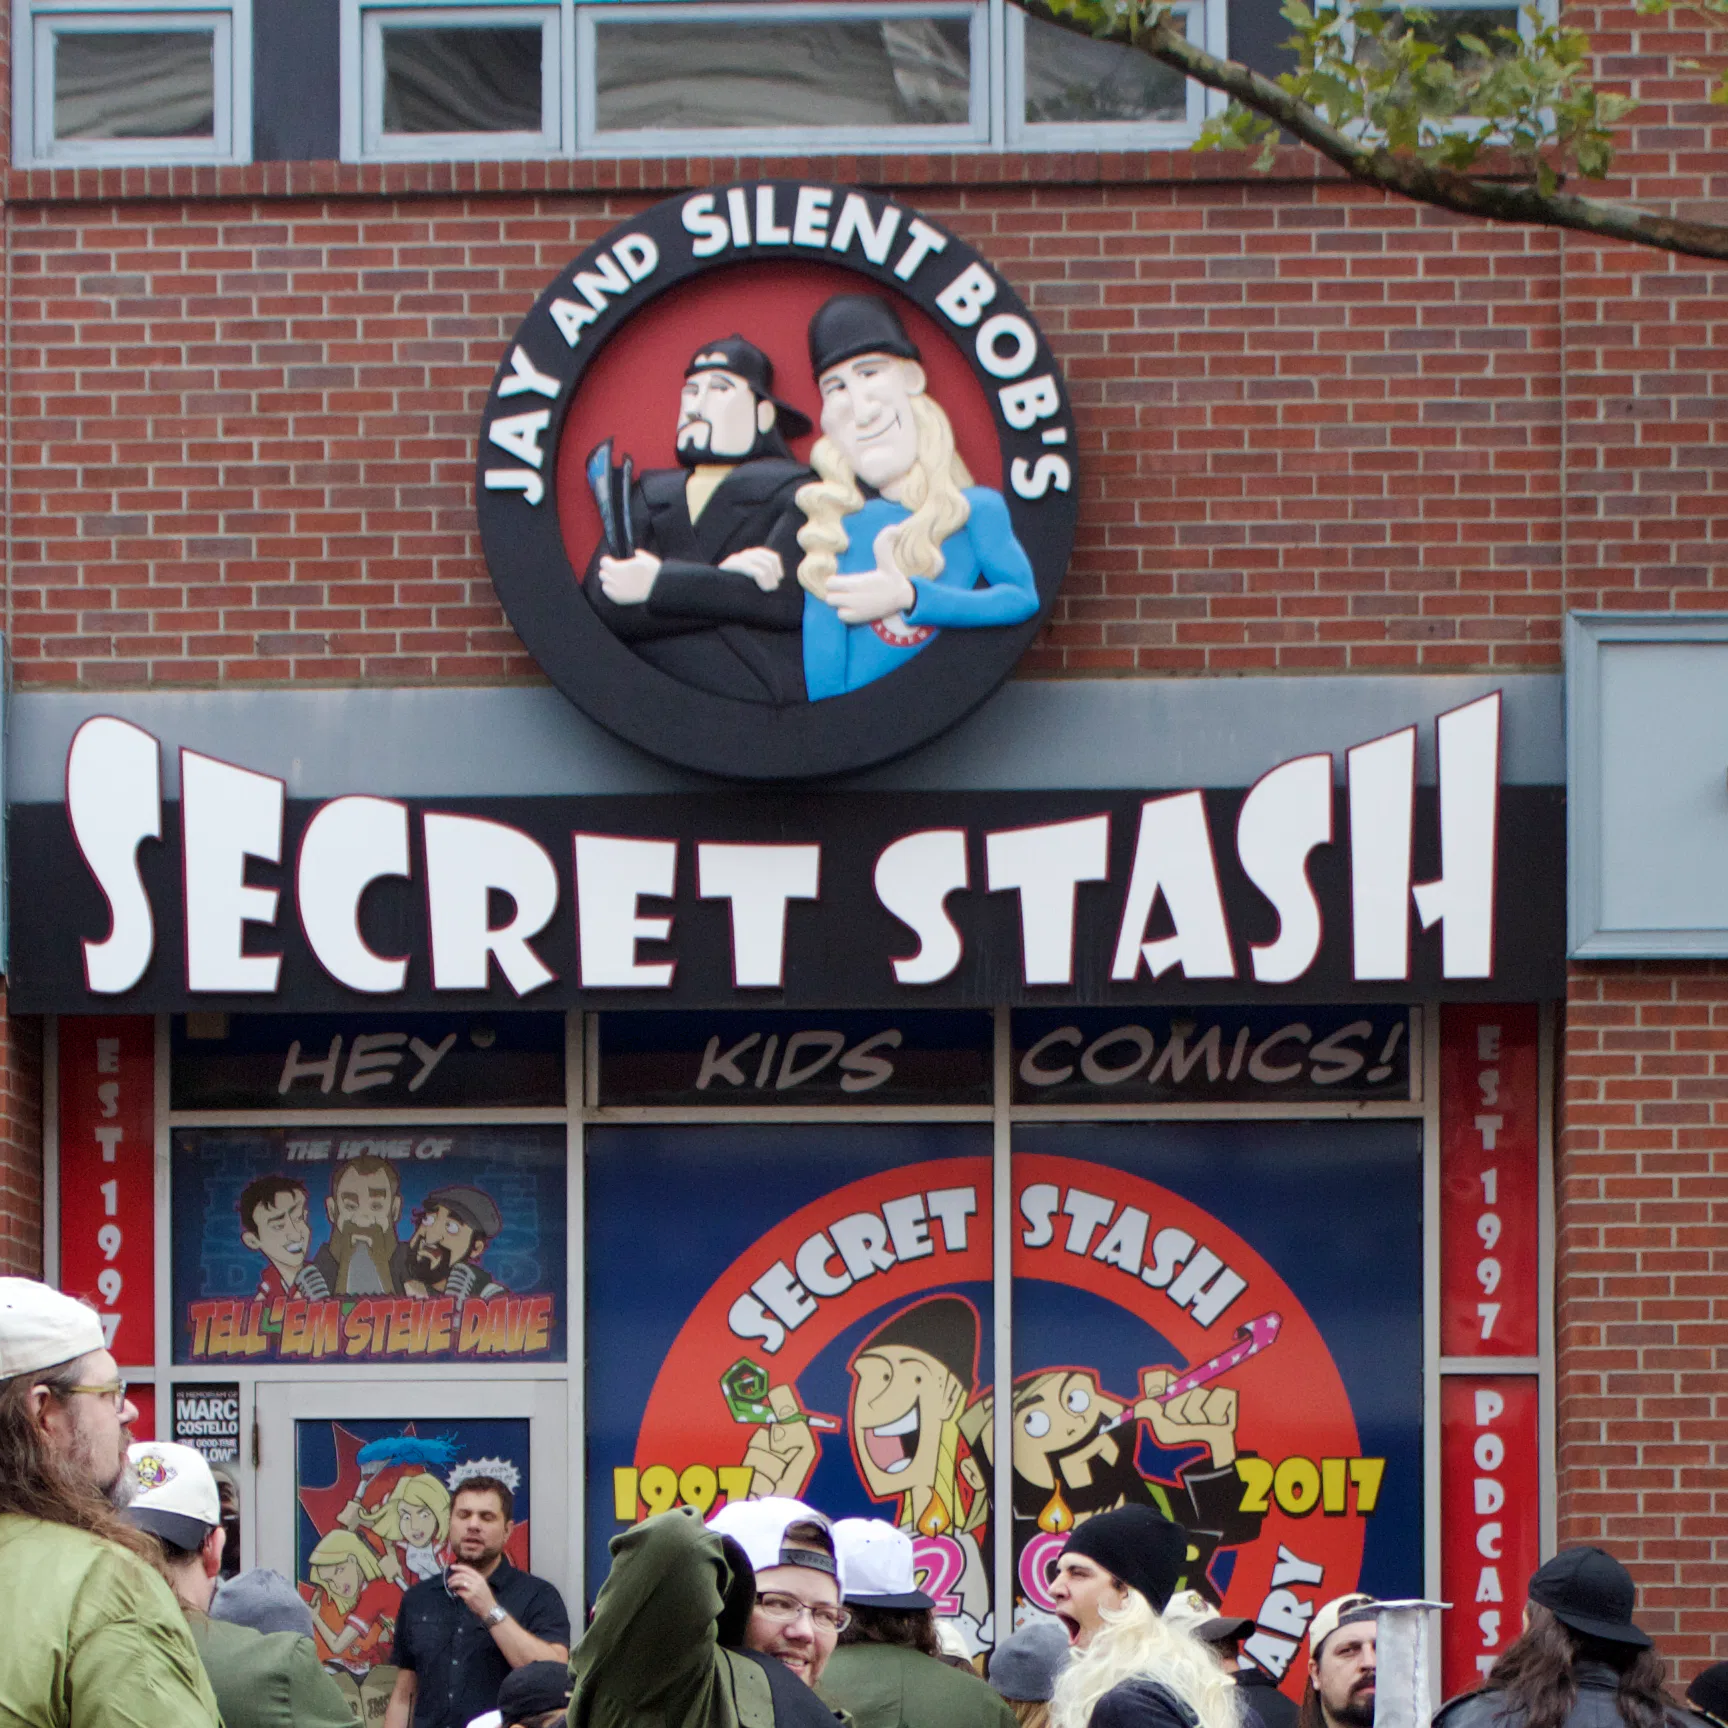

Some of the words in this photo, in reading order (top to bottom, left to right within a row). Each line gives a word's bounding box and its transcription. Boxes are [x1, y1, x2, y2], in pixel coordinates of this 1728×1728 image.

[483, 345, 562, 506] JAY
[548, 231, 659, 347] AND
[680, 184, 948, 282] SILENT
[934, 261, 1073, 501] BOB'S
[65, 712, 822, 998] SECRET
[871, 688, 1504, 985] STASH
[94, 1037, 123, 1162] EST
[277, 1031, 459, 1094] HEY
[695, 1028, 904, 1093] KIDS
[1018, 1020, 1405, 1087] COMICS!
[1474, 1024, 1505, 1151] EST
[285, 1139, 332, 1161] THE
[335, 1138, 414, 1161] HOME
[413, 1137, 455, 1161] OF
[96, 1179, 123, 1350] 1997
[727, 1185, 978, 1356] SECRET
[1019, 1182, 1250, 1331] STASH
[1475, 1167, 1503, 1341] 1997
[190, 1298, 267, 1358] TELL
[342, 1297, 456, 1358] STEVE
[458, 1296, 553, 1356] DAVE
[176, 1399, 238, 1420] MARC
[176, 1421, 239, 1435] COSTELLO
[613, 1464, 756, 1524] 1997
[1235, 1455, 1387, 1518] 2017
